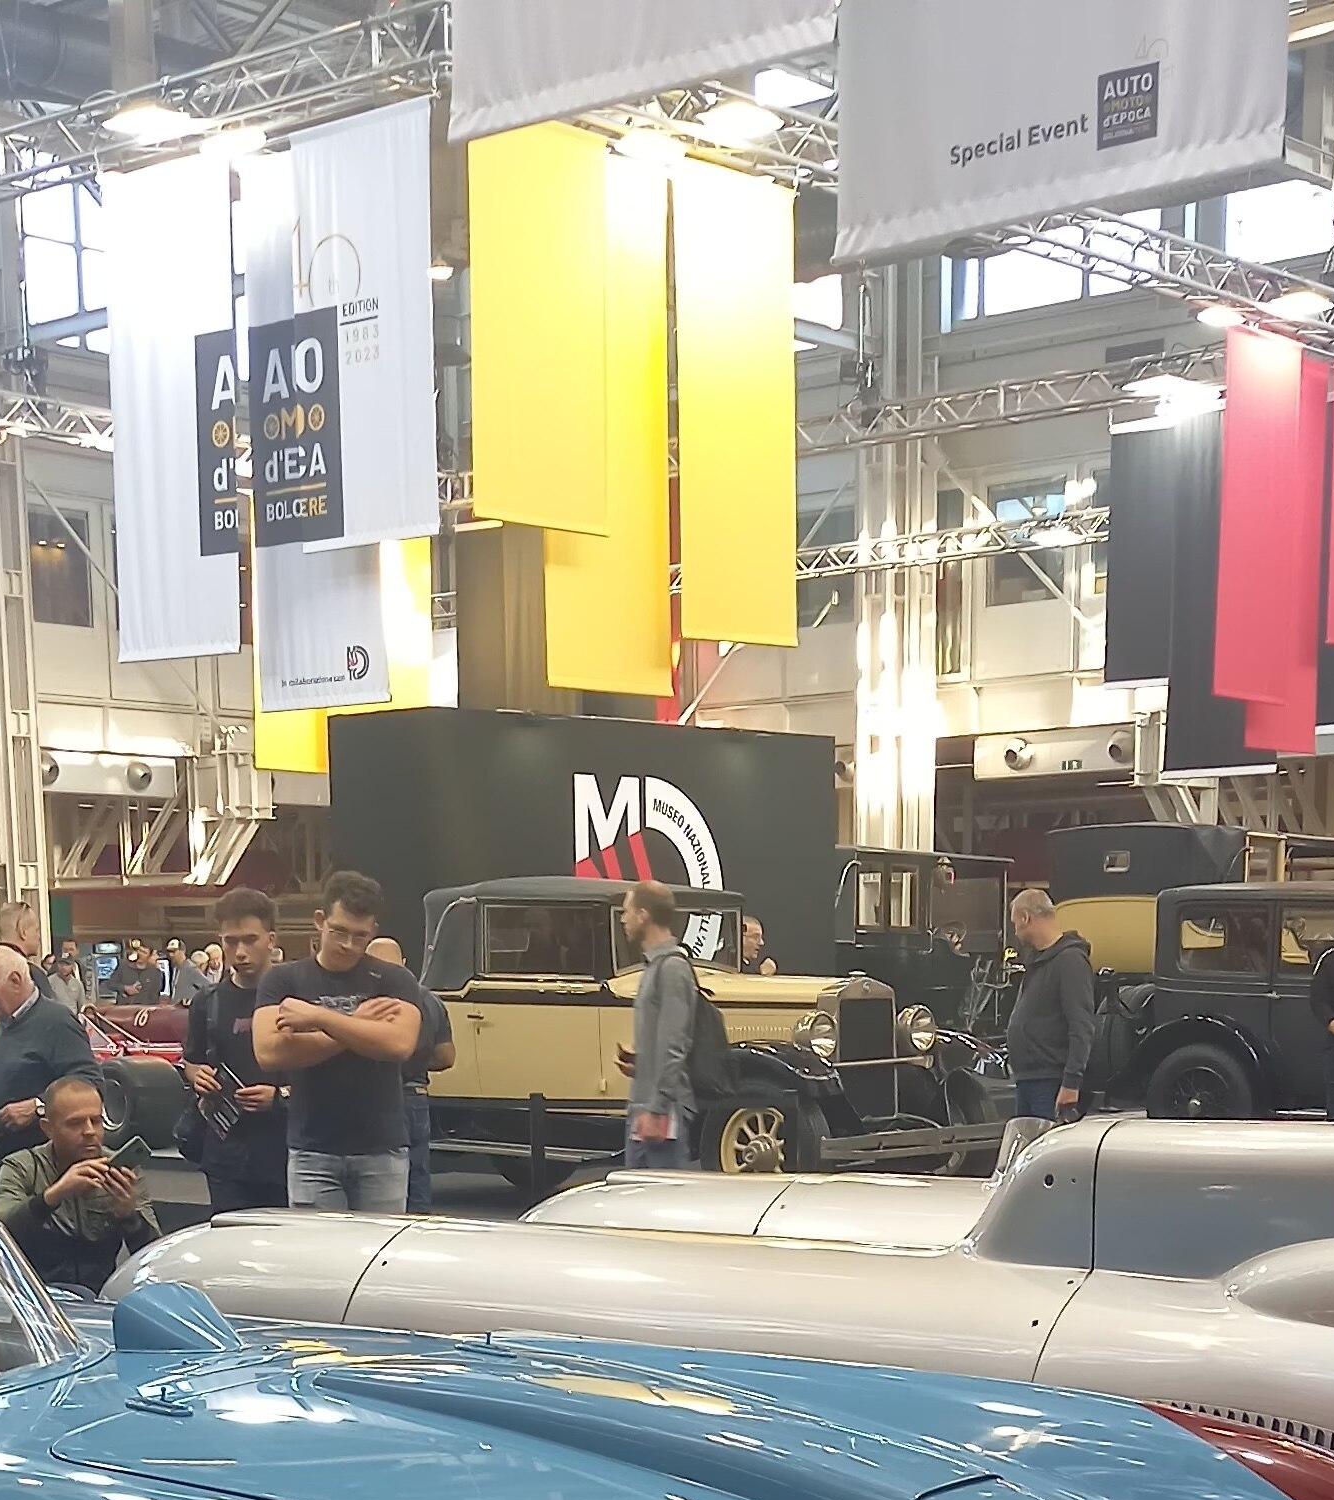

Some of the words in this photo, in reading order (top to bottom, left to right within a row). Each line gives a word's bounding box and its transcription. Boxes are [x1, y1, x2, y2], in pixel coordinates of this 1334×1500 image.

[1103, 72, 1153, 101] AUTO
[1103, 106, 1152, 128] d'EPOCA
[950, 128, 1022, 168] Special
[1028, 113, 1089, 147] Event
[342, 298, 379, 317] EDITION
[345, 324, 379, 345] 1983
[652, 798, 686, 829] MUSEO
